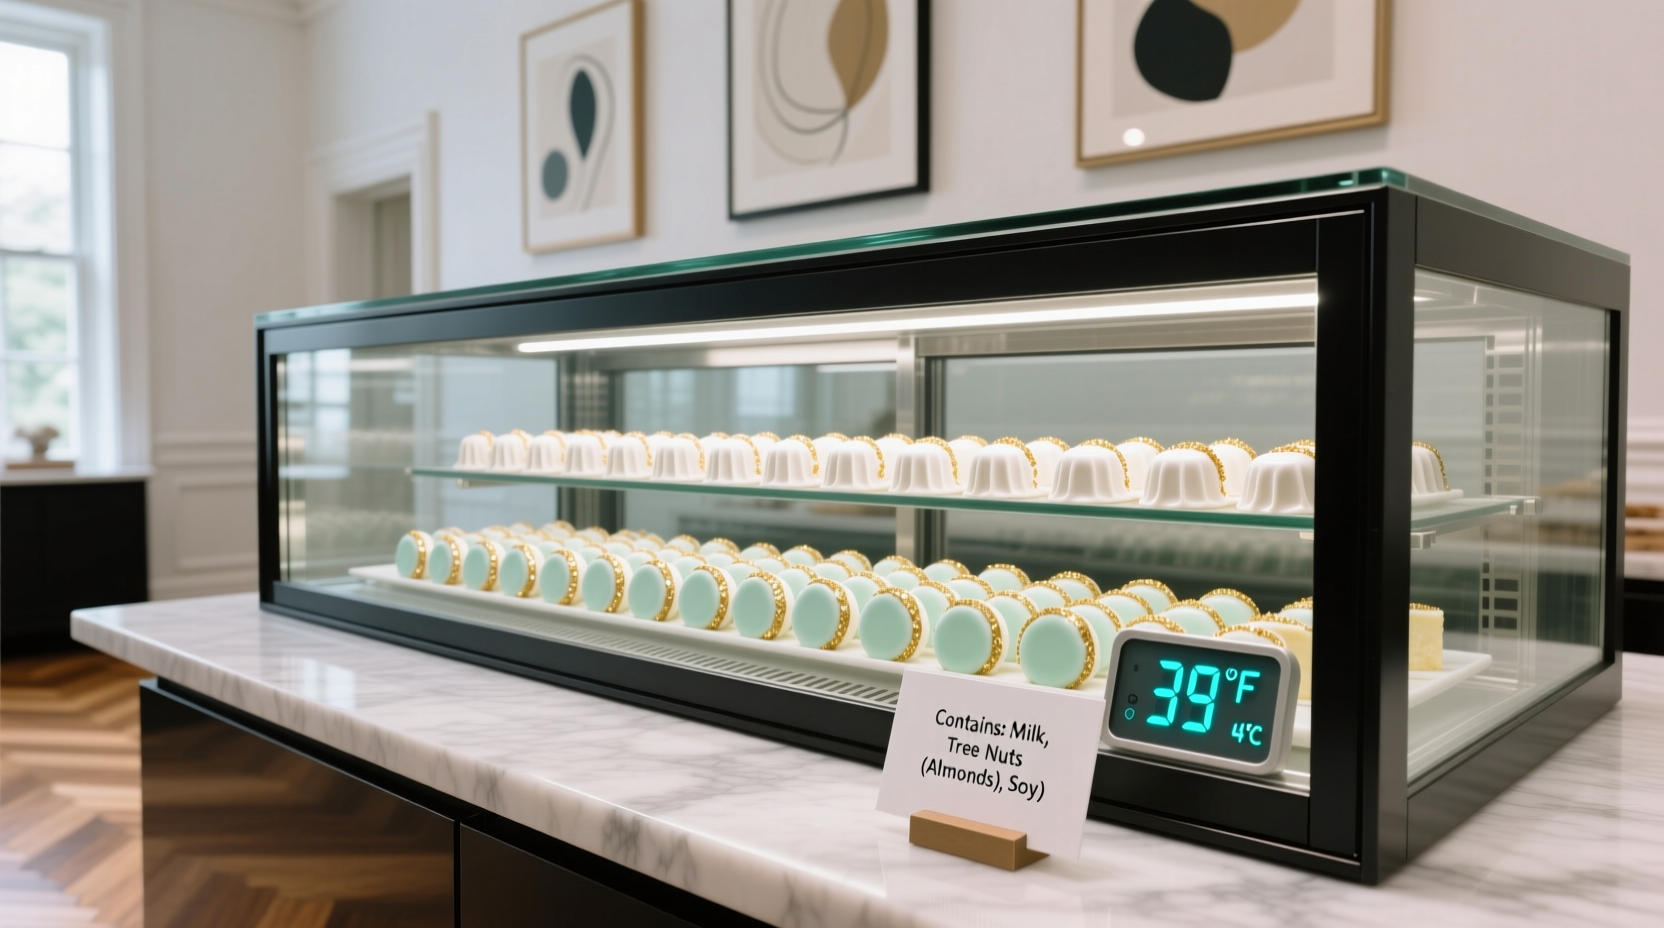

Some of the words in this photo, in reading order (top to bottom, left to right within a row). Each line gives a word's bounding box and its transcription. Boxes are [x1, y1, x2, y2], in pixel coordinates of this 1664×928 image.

[935, 708, 1007, 737] Contains:
[1009, 720, 1049, 749] Milk,
[947, 736, 980, 758] Tree
[984, 743, 1023, 767] Nuts
[920, 756, 1003, 794] (Almonds),
[1007, 774, 1045, 803] Soy)
